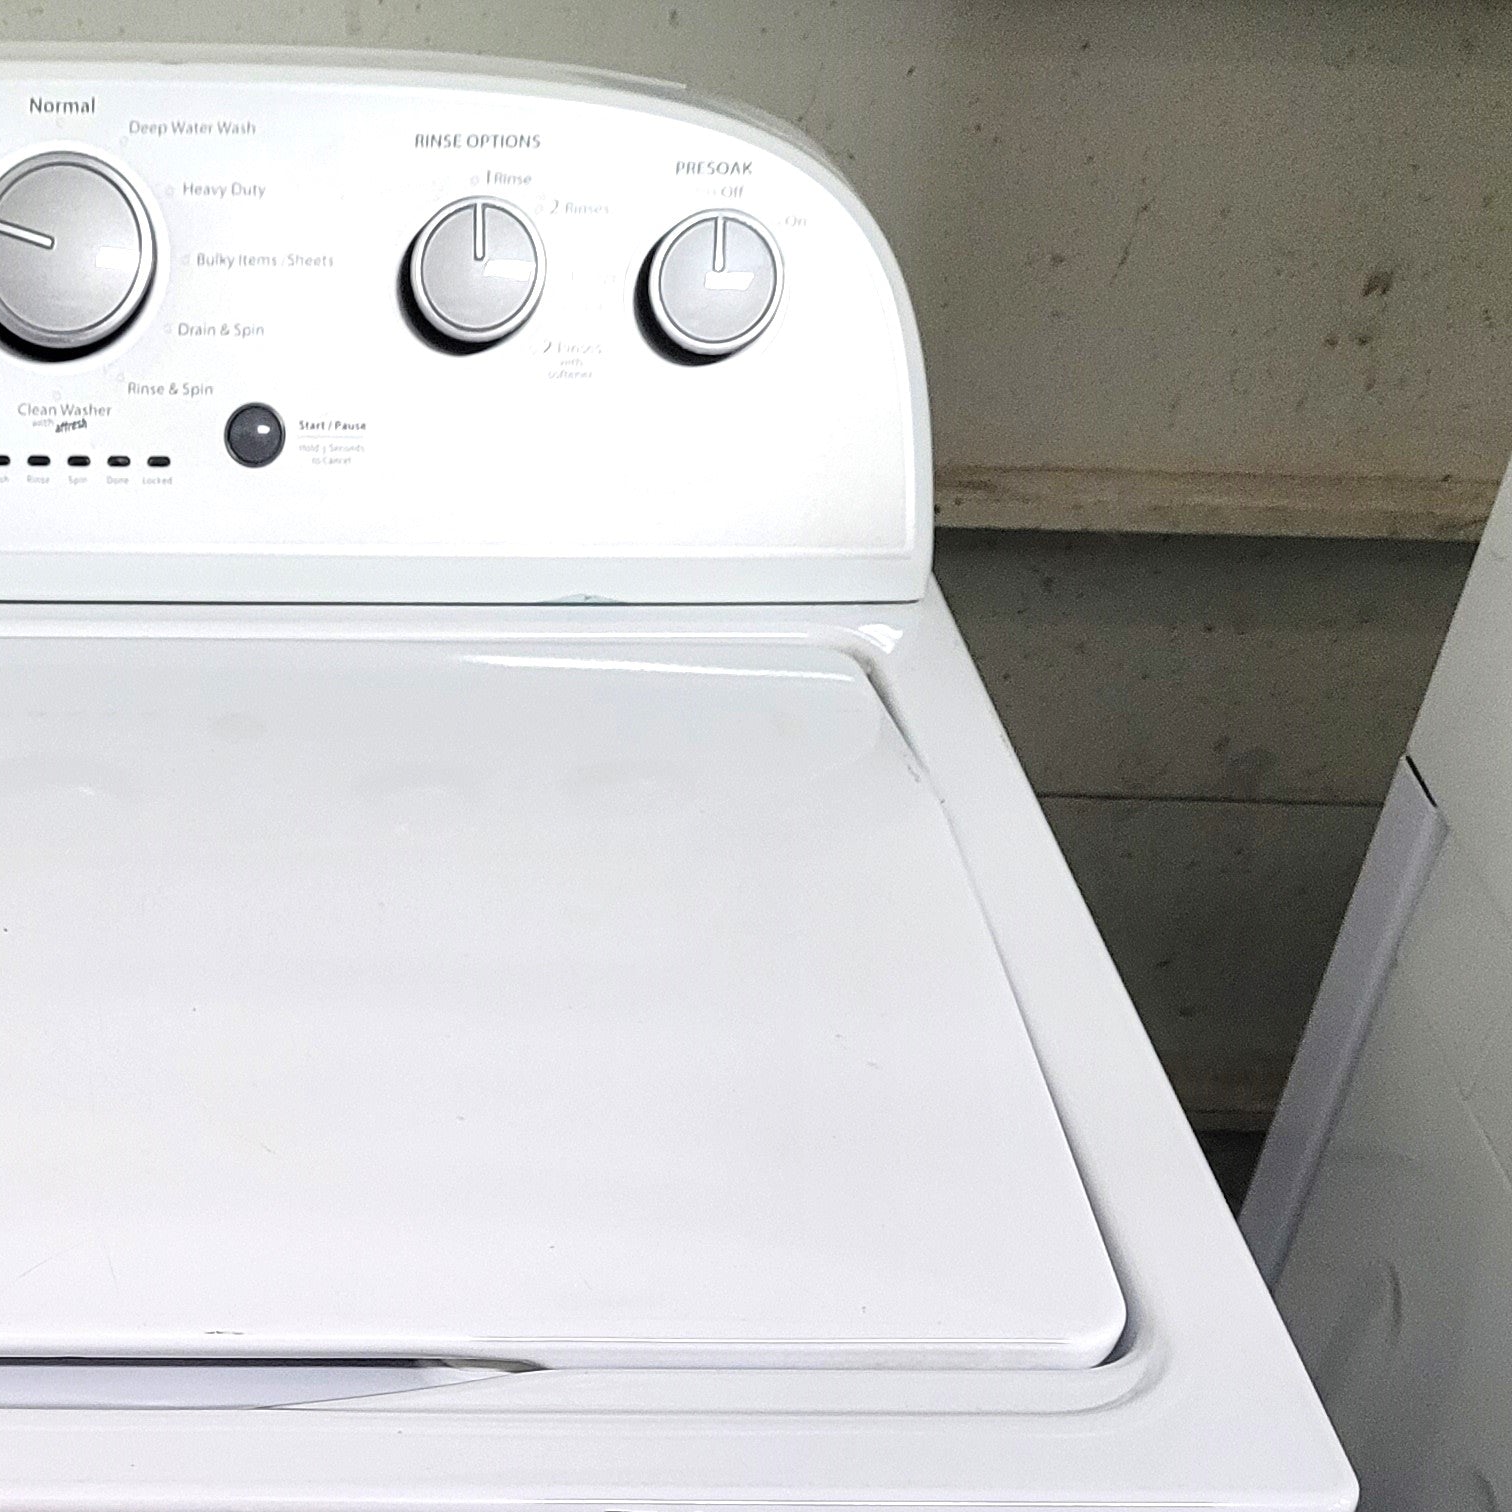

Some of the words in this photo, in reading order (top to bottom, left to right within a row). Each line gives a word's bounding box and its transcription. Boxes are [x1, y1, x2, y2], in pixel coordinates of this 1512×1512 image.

[30, 98, 95, 114] Normal
[129, 121, 167, 137] Deep
[171, 121, 212, 135] Water
[217, 121, 256, 135] Wash
[415, 134, 462, 148] RINSE
[467, 134, 541, 148] OPTIONS
[676, 161, 752, 175] PRESOAK
[486, 170, 491, 184] 1
[494, 172, 531, 185] Rinse
[183, 183, 226, 198] Heavy
[231, 183, 266, 199] Duty
[721, 185, 744, 198] Off
[197, 254, 235, 269] Bulky
[239, 255, 277, 267] Items
[288, 254, 334, 267] Sheets
[178, 323, 216, 336] Drain
[220, 323, 229, 336] &
[233, 323, 264, 338] Spin
[128, 383, 165, 395] Rinse
[169, 383, 179, 395] &
[182, 383, 213, 398] Spin
[18, 403, 58, 417] Clean
[62, 403, 111, 417] Washer
[299, 420, 325, 430] Start
[335, 421, 366, 430] Pause
